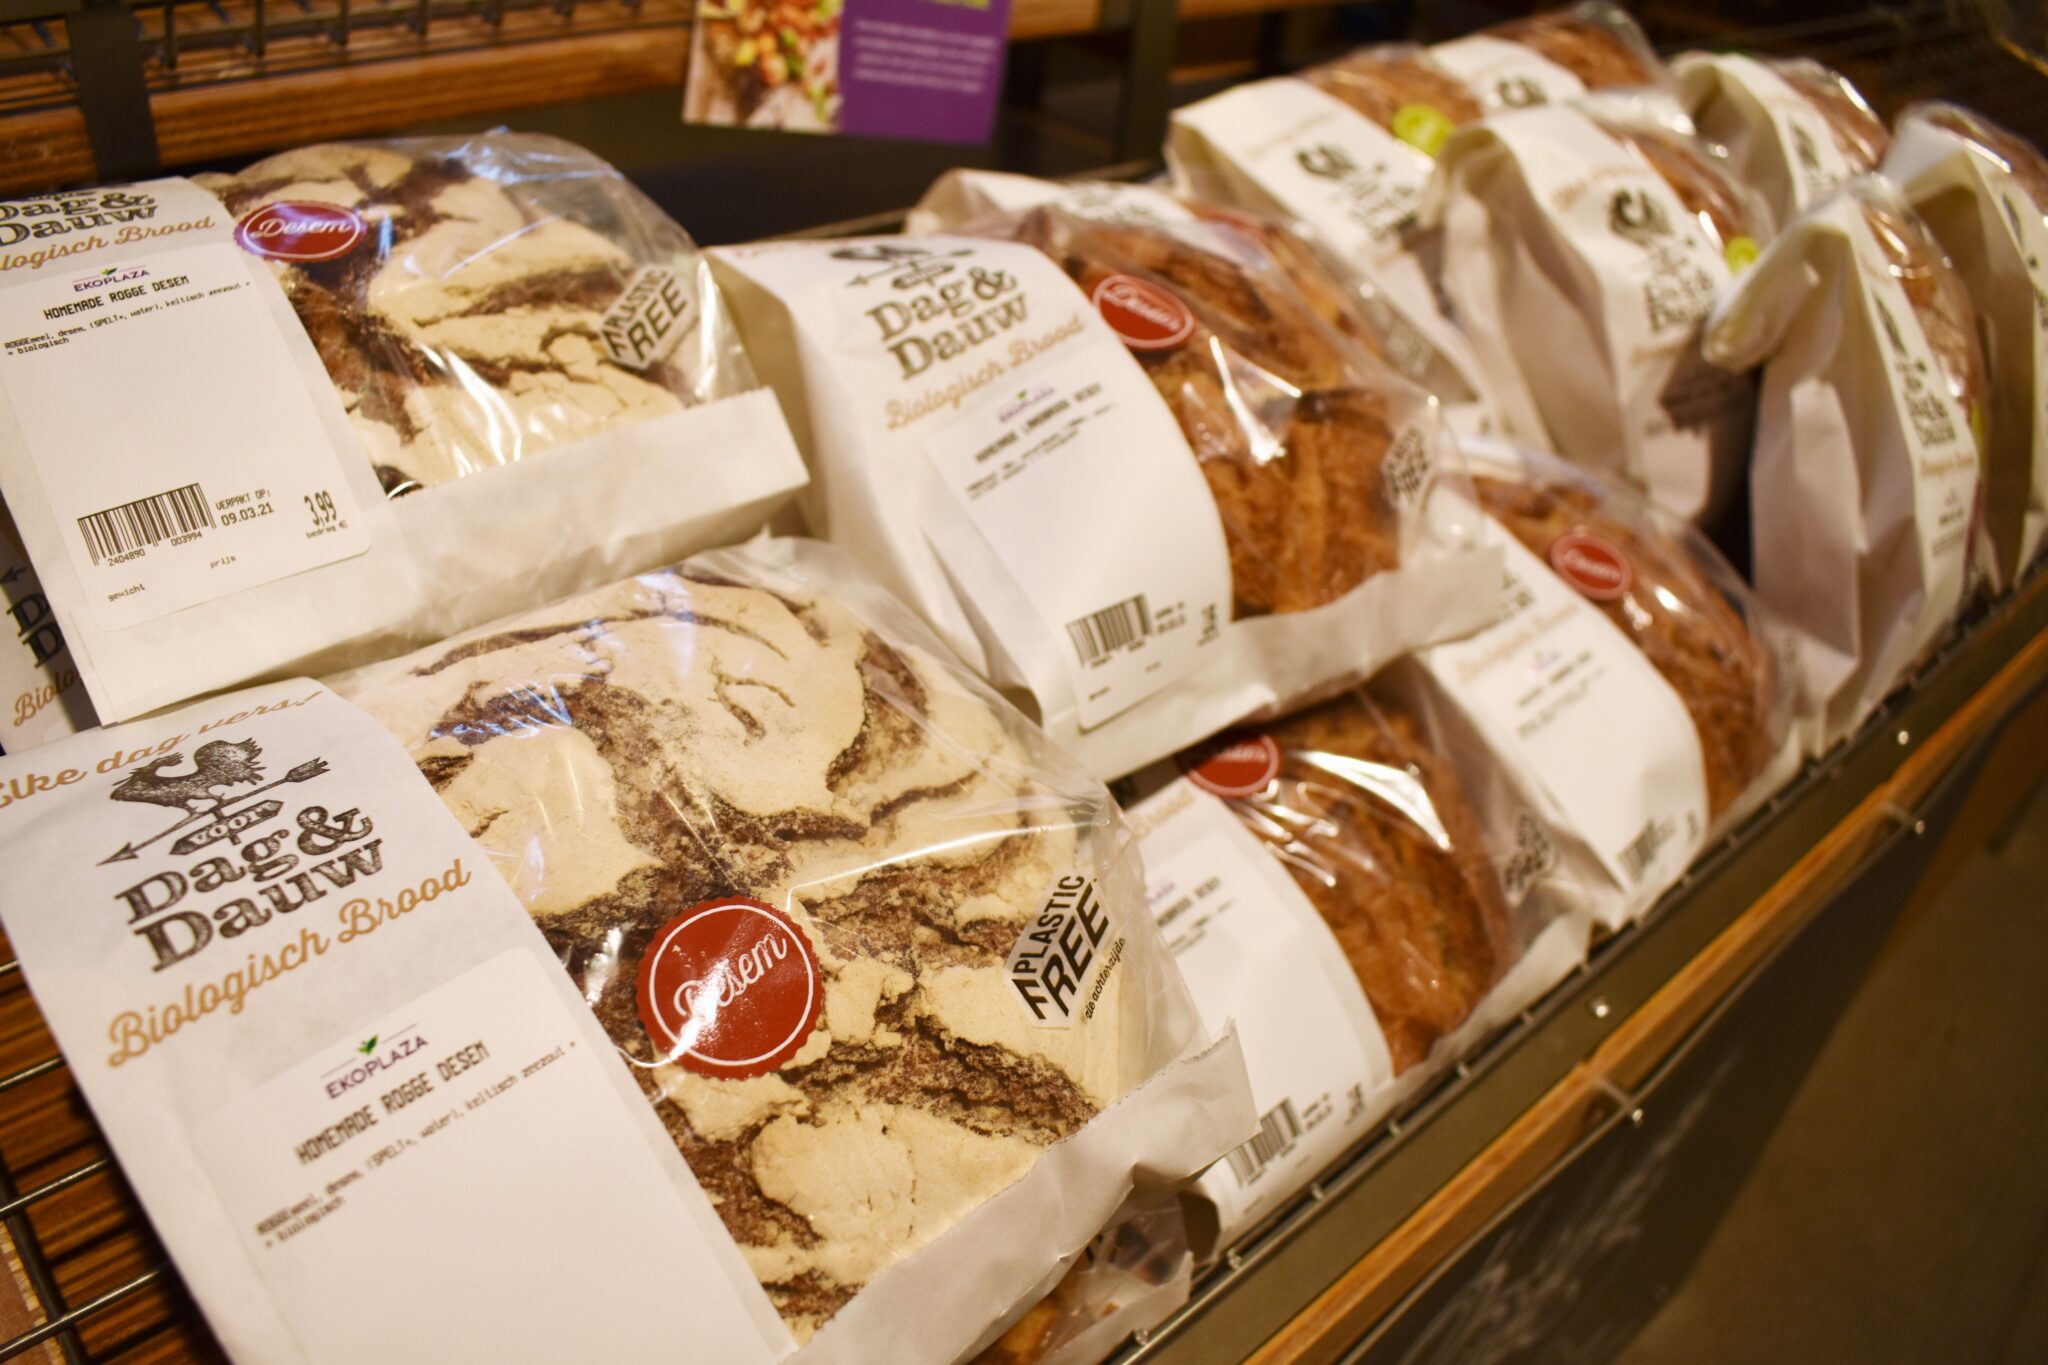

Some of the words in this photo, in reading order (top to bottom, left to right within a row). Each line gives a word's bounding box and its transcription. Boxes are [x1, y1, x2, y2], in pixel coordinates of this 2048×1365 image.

[114, 215, 215, 245] Brood
[250, 218, 353, 238] Desem
[43, 296, 104, 320] HOMEMADE
[109, 285, 147, 303] ROGGE
[152, 275, 189, 292] DESEM
[73, 269, 150, 292] EKOPLAZA
[17, 337, 69, 354] biologisch
[887, 293, 1028, 381] Dauw
[215, 494, 251, 512] VERPAKT
[221, 502, 274, 526] 09.03.21
[304, 489, 337, 527] 3,99
[107, 548, 146, 567] 2404890
[170, 531, 203, 547] 003994
[107, 583, 146, 602] gewicht
[96, 733, 191, 774] dag
[133, 838, 384, 972] Dauw
[1012, 875, 1086, 974] PLASTIC
[107, 926, 330, 1067] Biologisch
[338, 858, 472, 942] Brood
[1012, 882, 1110, 1020] FREE
[325, 1034, 429, 1100] EKOPLAZA
[296, 1104, 379, 1165] HOMEMADE
[381, 1072, 435, 1114] ROGGE
[437, 1039, 491, 1082] DESEM
